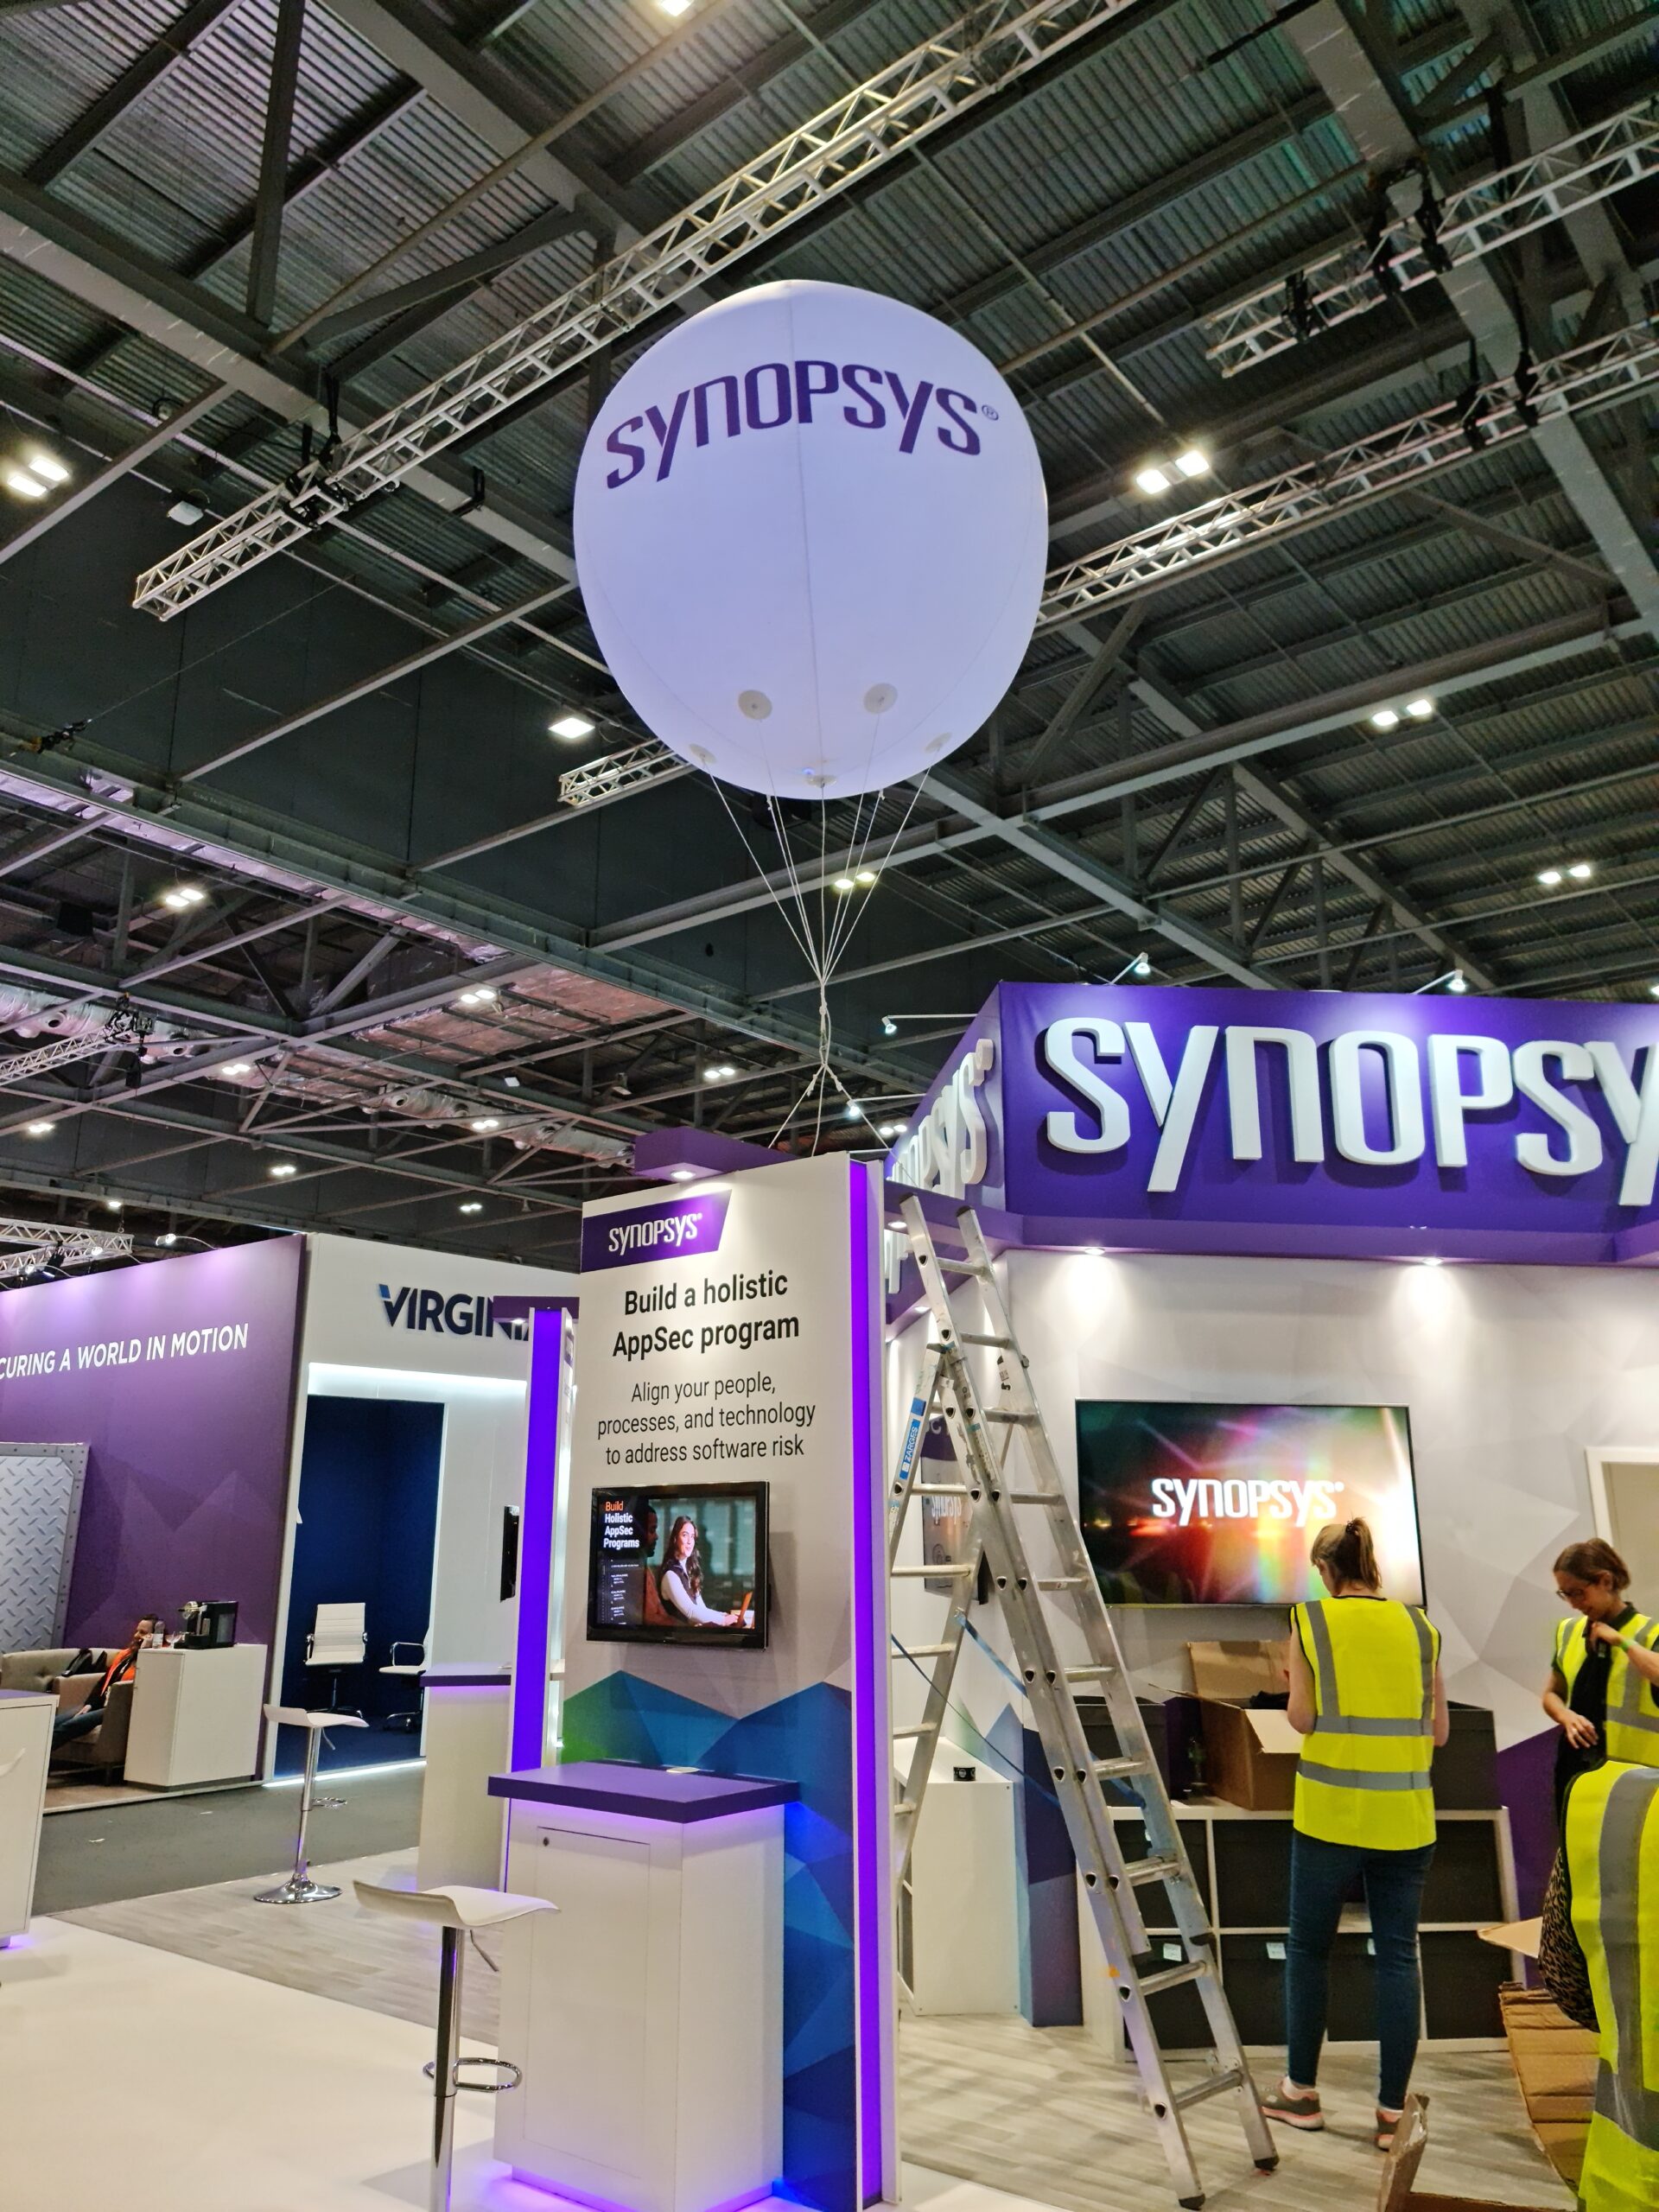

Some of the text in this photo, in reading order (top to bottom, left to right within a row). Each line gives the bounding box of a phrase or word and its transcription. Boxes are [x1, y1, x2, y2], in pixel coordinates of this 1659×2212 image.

[625, 1269, 788, 1315] Build a holistic
[59, 1348, 71, 1372] A
[78, 1338, 142, 1369] WORLD
[146, 1335, 166, 1360] IN
[170, 1323, 249, 1357] MOTION
[612, 1325, 694, 1362] AppSec
[701, 1316, 799, 1354] program
[632, 1371, 776, 1406] Align your people,
[598, 1402, 816, 1440] processes, and technology
[606, 1433, 804, 1465] to address software risk
[904, 1426, 919, 1462] ZARGES
[604, 1513, 633, 1523] Holistic
[605, 1501, 624, 1511] Build
[603, 1537, 640, 1550] Programs
[604, 1525, 633, 1537] AppSec
